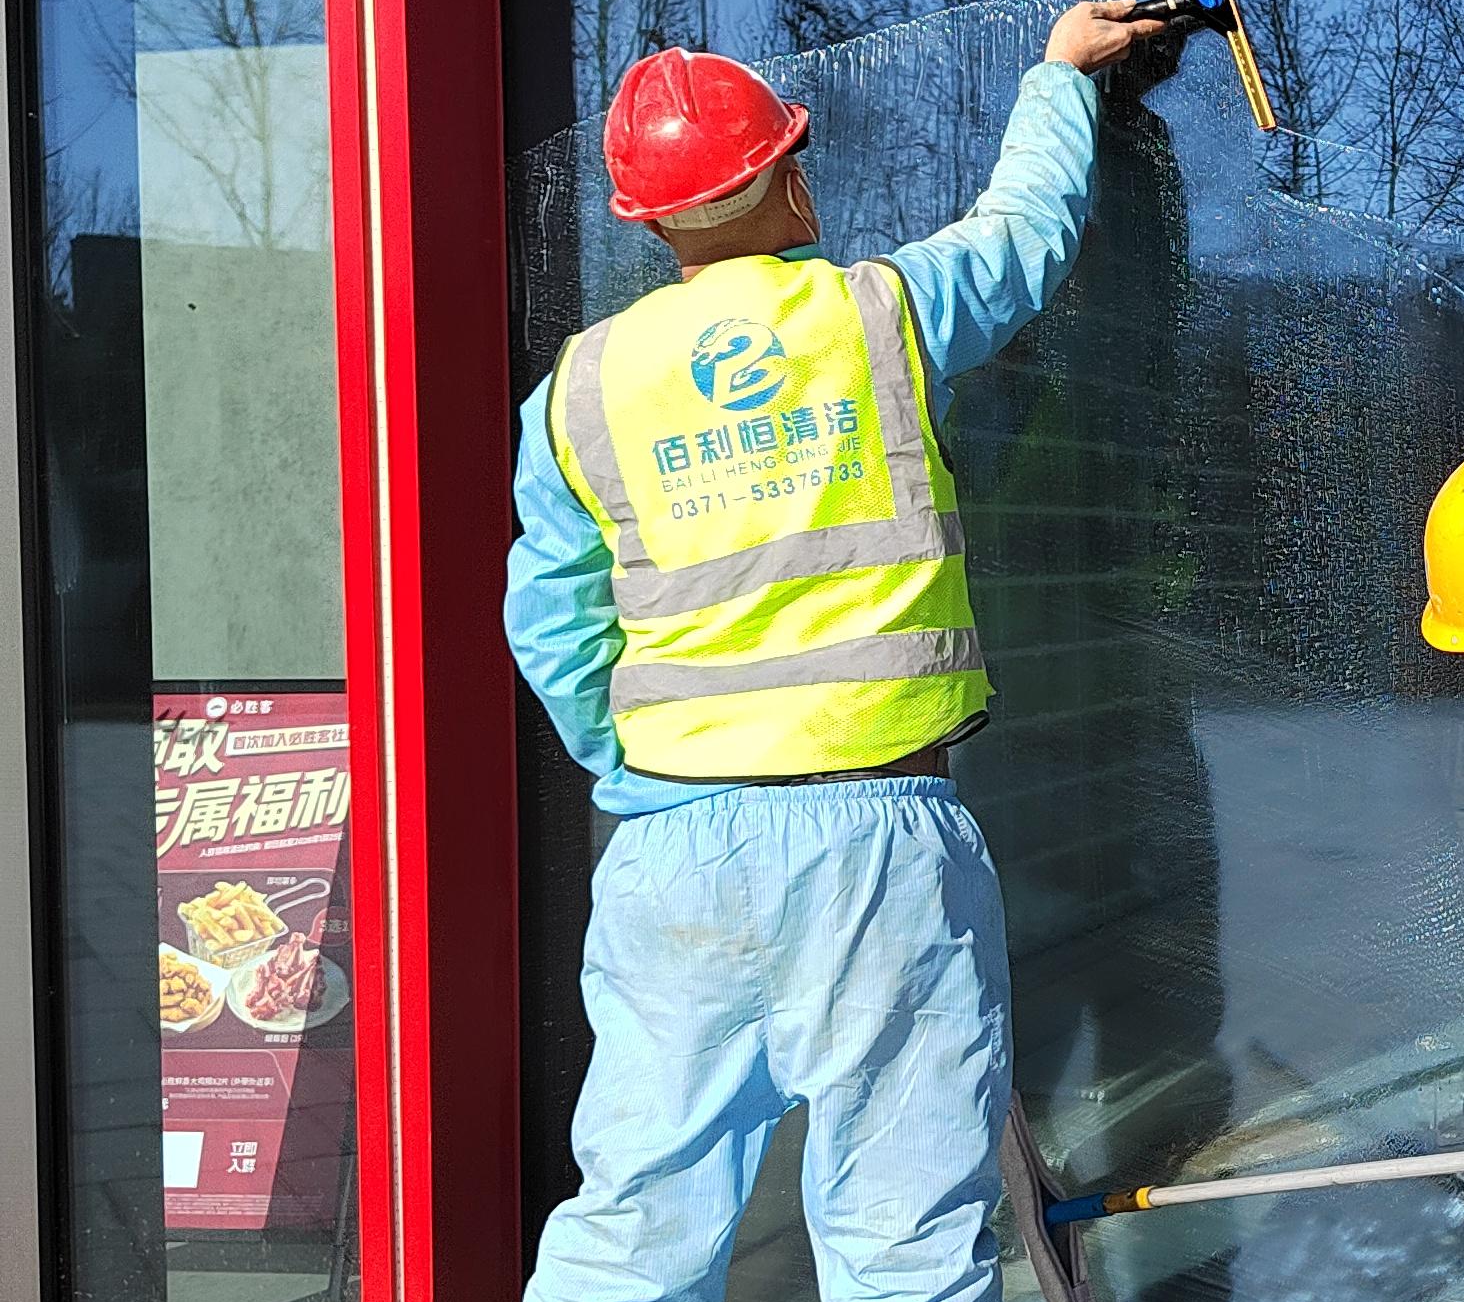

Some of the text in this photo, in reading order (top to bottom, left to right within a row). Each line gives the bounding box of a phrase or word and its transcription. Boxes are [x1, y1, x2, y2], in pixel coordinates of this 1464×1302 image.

[652, 399, 860, 475] 佰利恒清洁
[662, 436, 861, 493] BAI LI HENG QING JIE
[671, 461, 864, 520] 0371-53376733
[230, 700, 274, 714] 必胜客
[154, 718, 229, 778] 取
[230, 1141, 258, 1157] 立即
